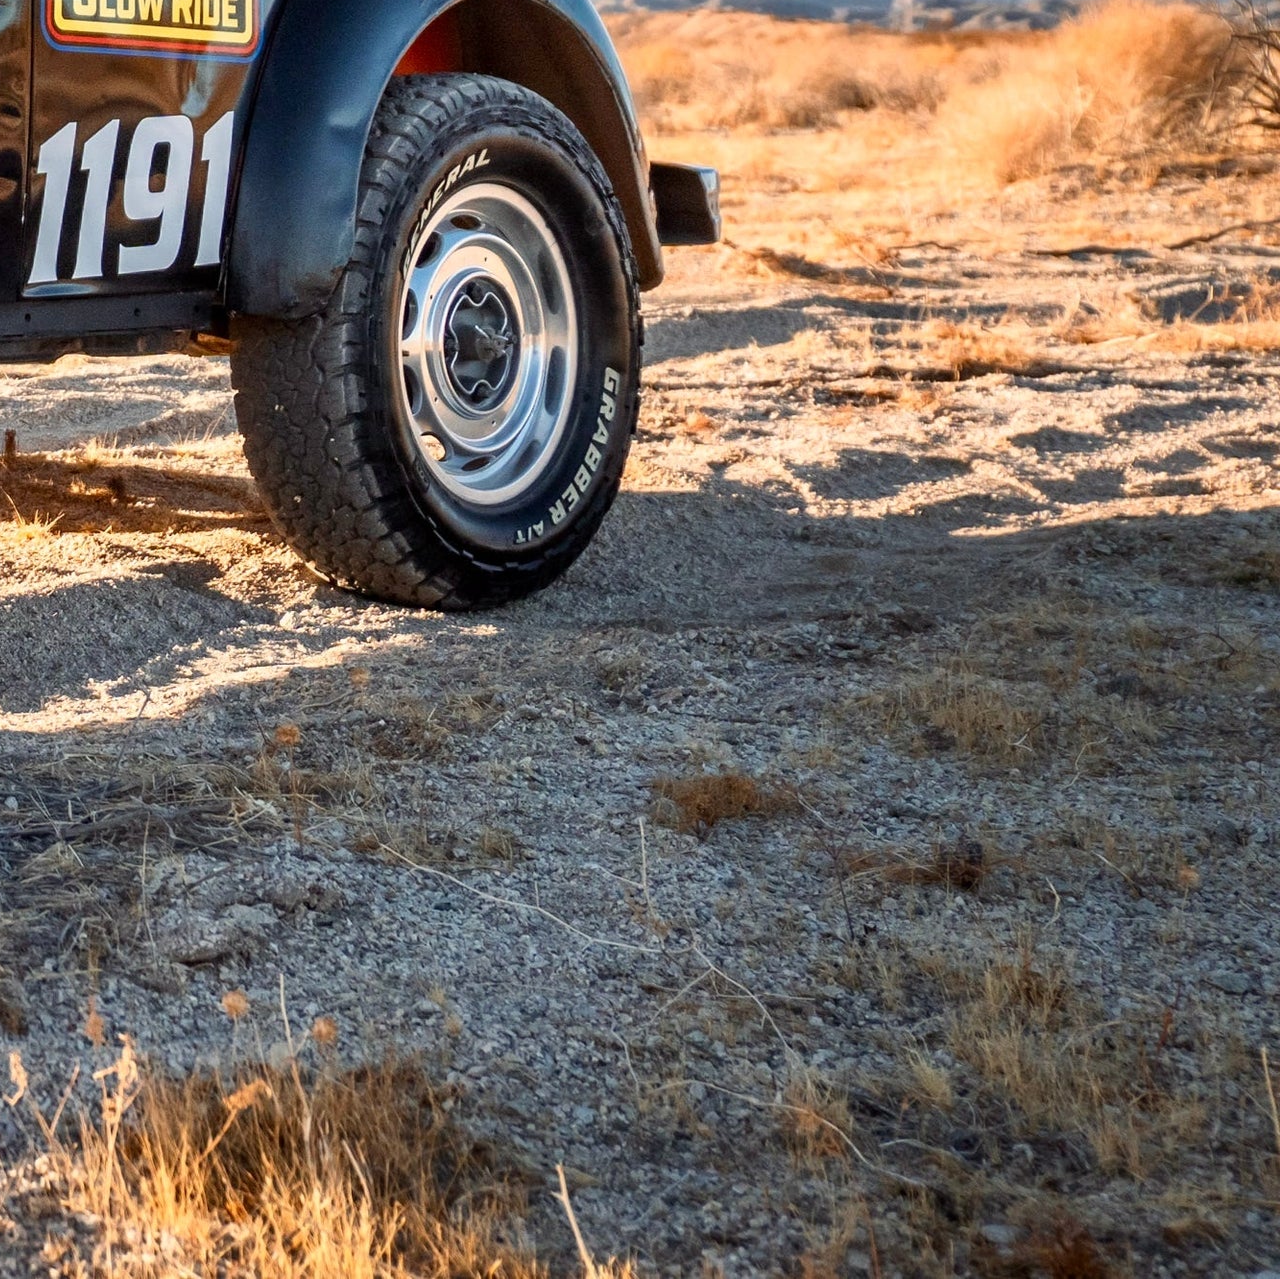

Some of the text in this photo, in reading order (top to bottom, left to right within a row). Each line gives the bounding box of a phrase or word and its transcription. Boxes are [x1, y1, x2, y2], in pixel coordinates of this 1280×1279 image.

[27, 110, 235, 284] 1191
[513, 366, 621, 545] GRABBER A/T
